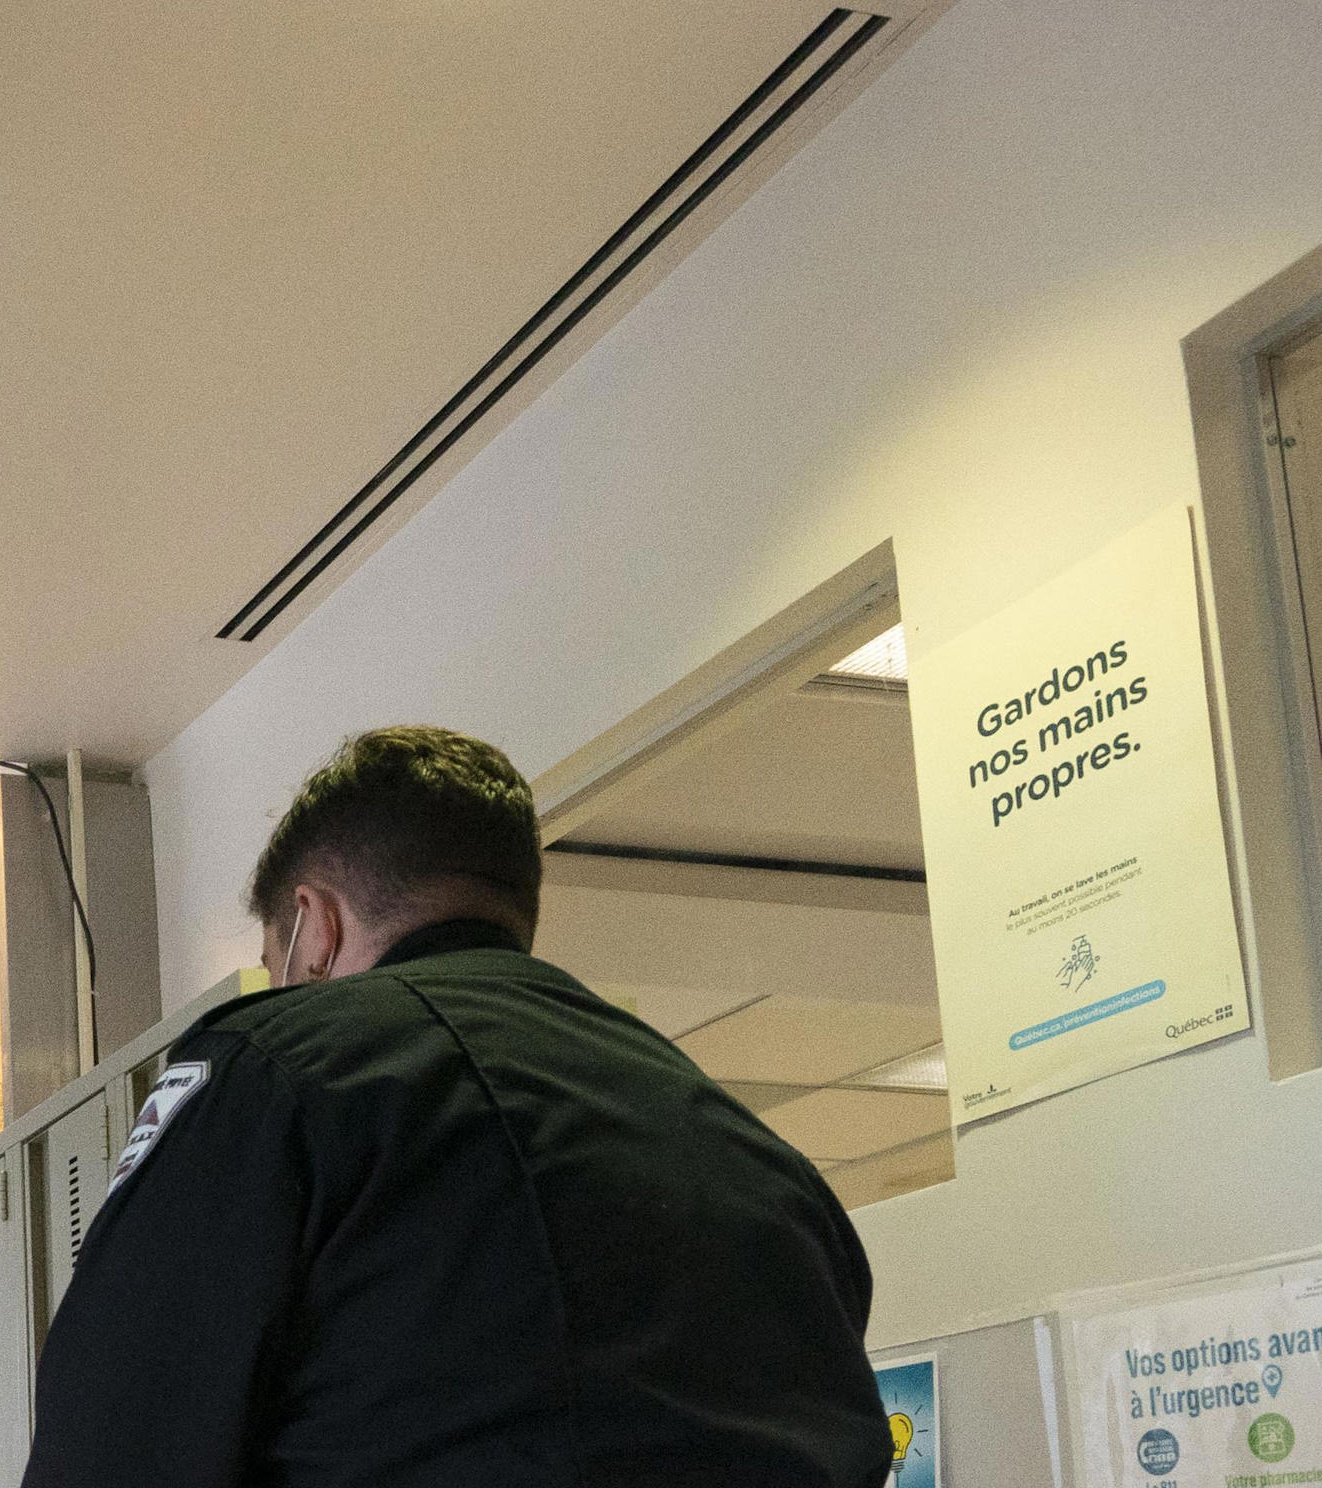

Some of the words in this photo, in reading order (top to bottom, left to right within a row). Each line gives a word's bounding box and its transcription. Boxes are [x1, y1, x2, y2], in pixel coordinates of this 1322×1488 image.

[976, 640, 1129, 738] Gardons
[968, 739, 1029, 788] nos
[1038, 676, 1149, 753] mains
[992, 731, 1142, 828] propres.
[1008, 907, 1020, 918] Au
[1051, 888, 1063, 900] on
[1064, 884, 1075, 894] se
[1075, 875, 1095, 889] lave
[1095, 868, 1109, 880] les
[1110, 856, 1138, 874] mains
[1165, 1013, 1215, 1040] Québec
[1125, 1348, 1167, 1379] Vos
[1171, 1335, 1262, 1377] options
[1268, 1326, 1322, 1359] avan
[1130, 1390, 1144, 1419] à
